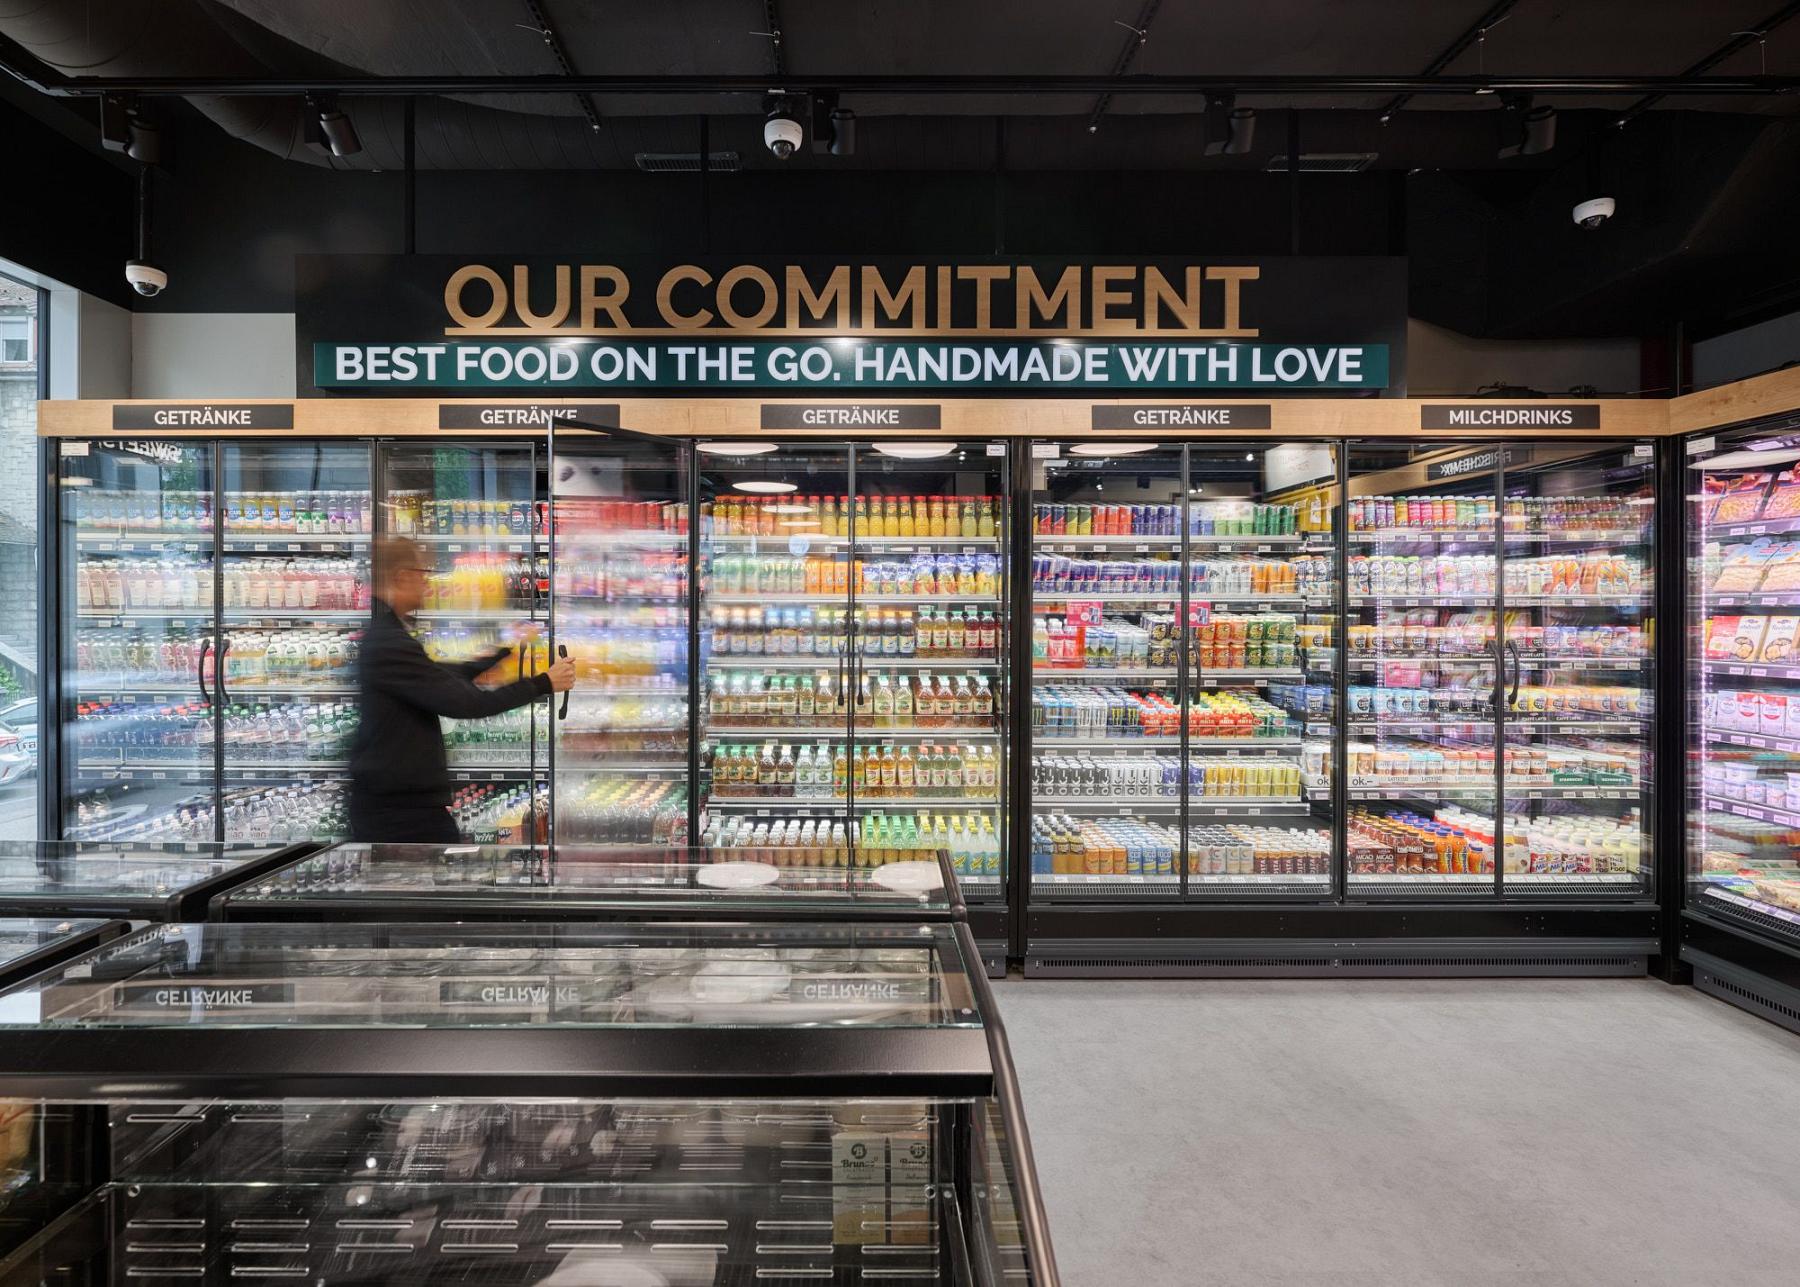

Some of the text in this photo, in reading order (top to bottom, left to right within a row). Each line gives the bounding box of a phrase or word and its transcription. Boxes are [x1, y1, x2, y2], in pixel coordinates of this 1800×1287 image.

[444, 264, 1260, 336] OUR COMMITMENT
[335, 345, 1363, 383] BEST FOOD ON THE GO. HANDMADE WITH LOVE
[154, 406, 252, 425] GETRÄNKE
[802, 406, 900, 425] GETRÄNKE
[1133, 406, 1231, 425] GETRÄNKE
[1449, 409, 1573, 425] MILCHDRINKS
